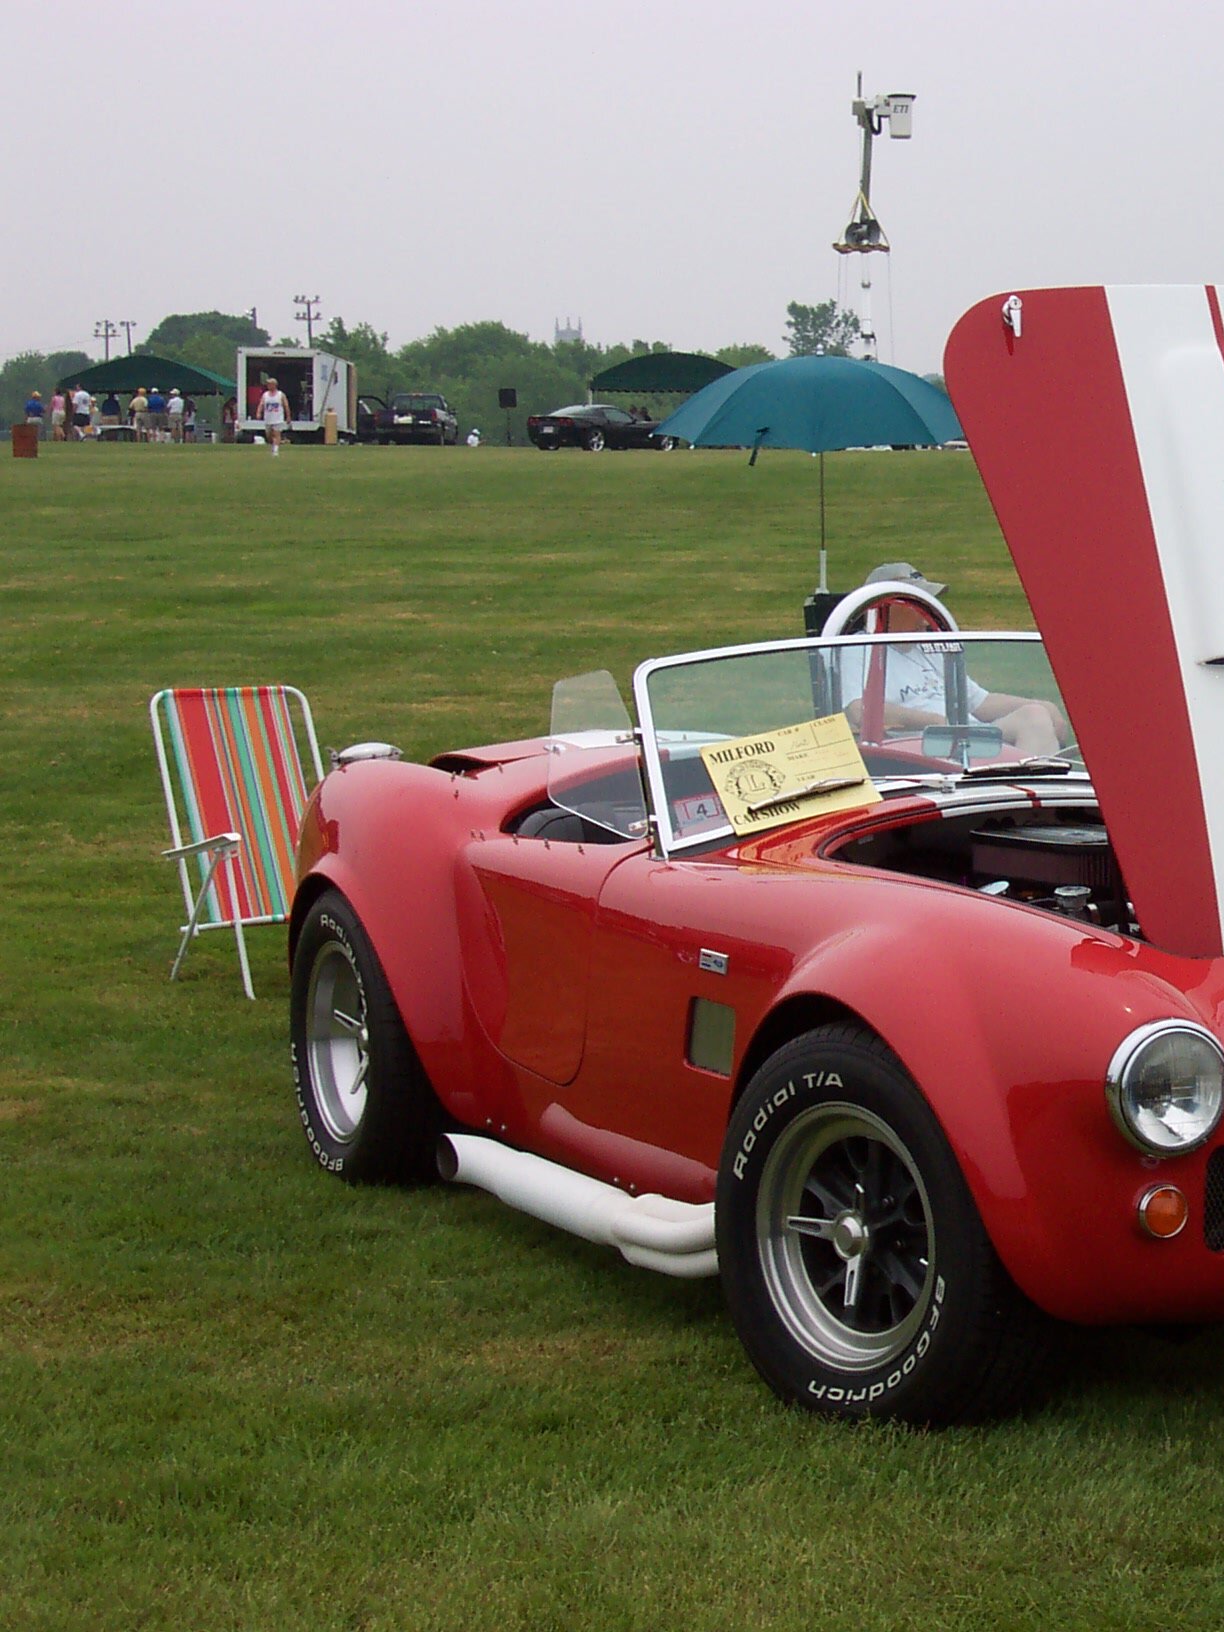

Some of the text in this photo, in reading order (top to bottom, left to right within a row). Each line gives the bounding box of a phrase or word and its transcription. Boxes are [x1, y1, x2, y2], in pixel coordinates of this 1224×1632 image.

[709, 740, 776, 766] MILFORD
[761, 801, 801, 818] SHOW
[733, 1071, 844, 1180] Radial T/A
[808, 1274, 946, 1405] BFGoodrich
